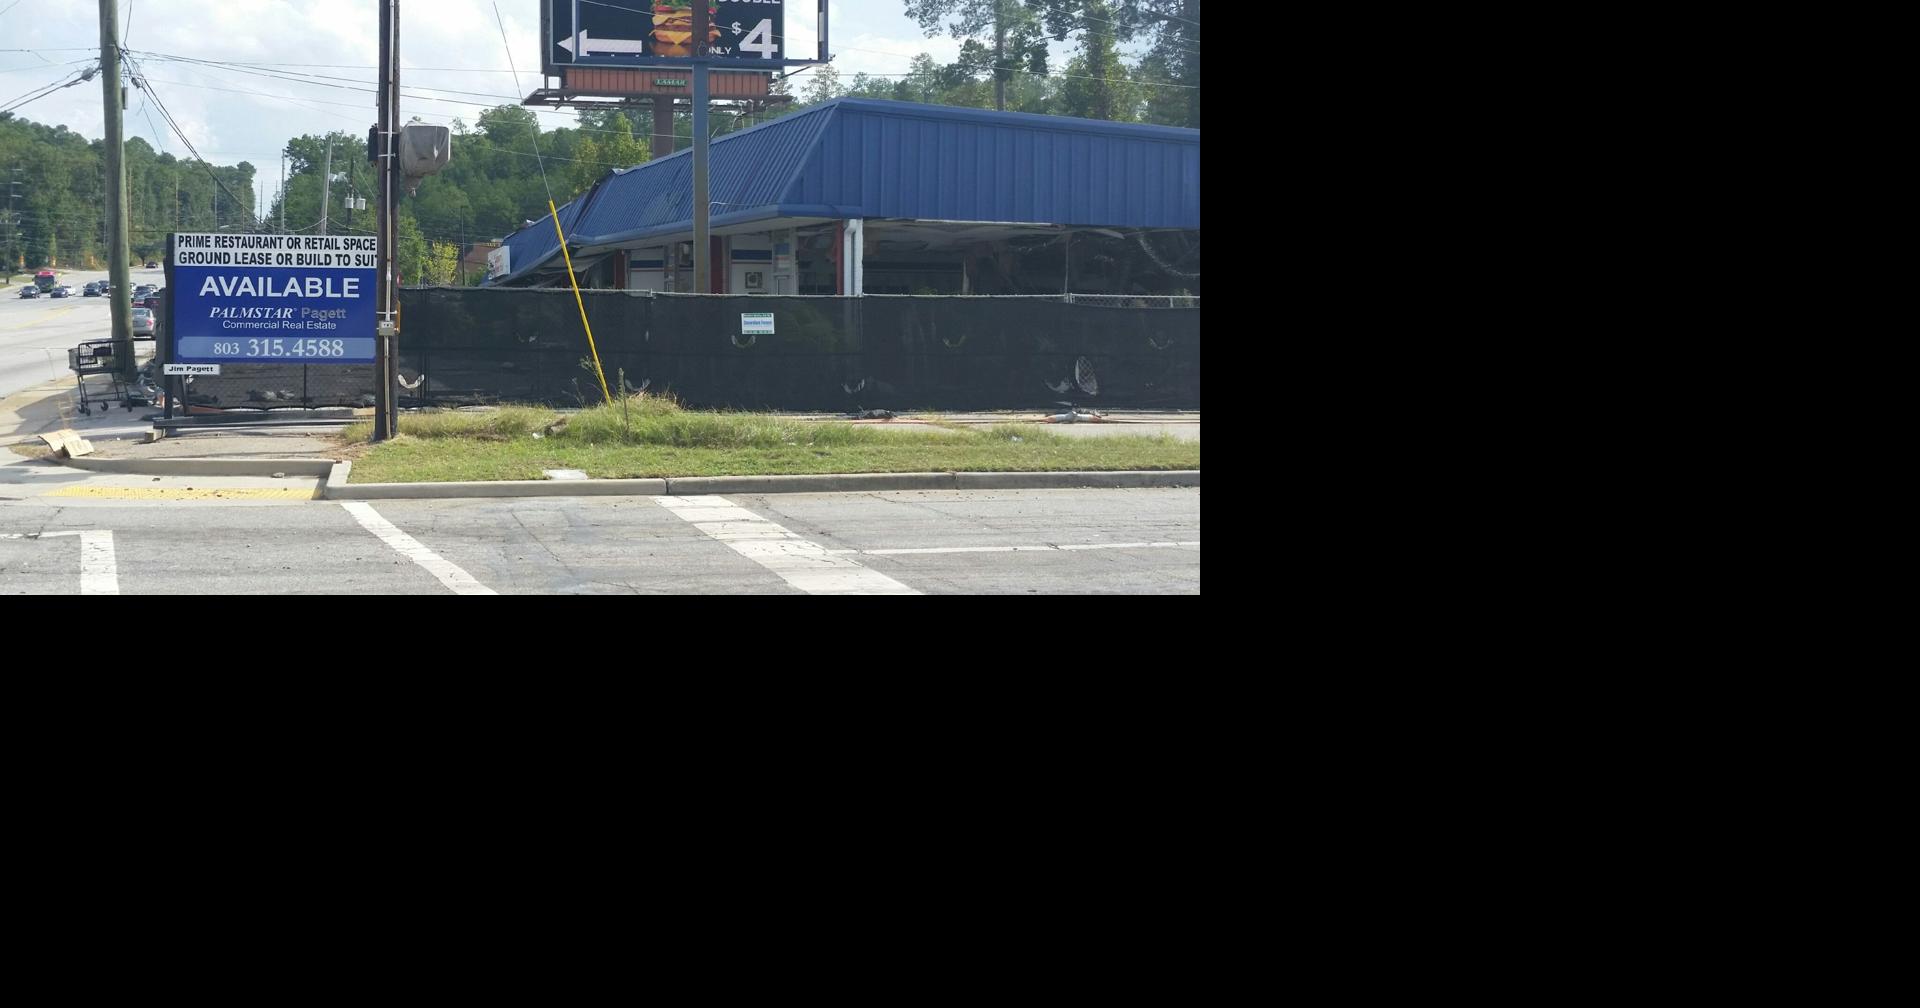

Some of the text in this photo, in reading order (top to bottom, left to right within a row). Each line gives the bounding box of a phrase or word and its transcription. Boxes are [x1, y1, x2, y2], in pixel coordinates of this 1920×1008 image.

[708, 46, 732, 55] NLY
[178, 235, 376, 251] PRIME RESTAURANT OR RETAIL SPACE
[178, 251, 377, 267] GROUND LEASE OR BUILD TO SUI
[199, 276, 360, 298] AVAILABLE
[301, 307, 347, 321] Pagett
[222, 320, 337, 330] Commercial Real Estate
[213, 339, 345, 357] 803 315.4588
[186, 365, 214, 373] Pagett
